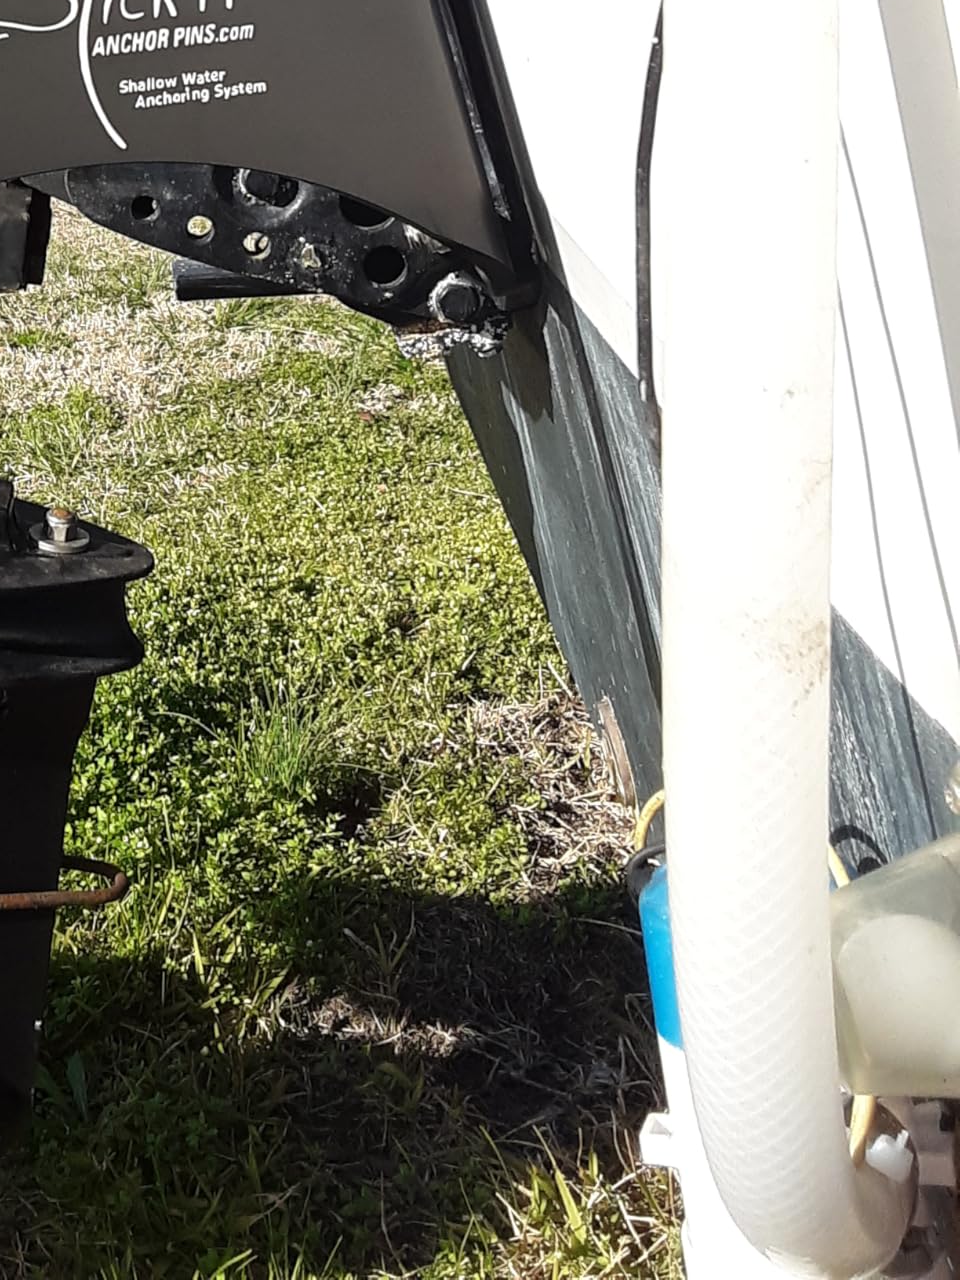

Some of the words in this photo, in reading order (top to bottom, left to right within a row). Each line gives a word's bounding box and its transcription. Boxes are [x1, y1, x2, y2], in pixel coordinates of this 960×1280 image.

[91, 26, 170, 57] ANCHOR
[172, 23, 256, 50] PINS.com
[118, 76, 179, 94] Shallow
[181, 70, 226, 88] Water
[134, 86, 210, 109] Anchoring
[213, 81, 267, 100] System
